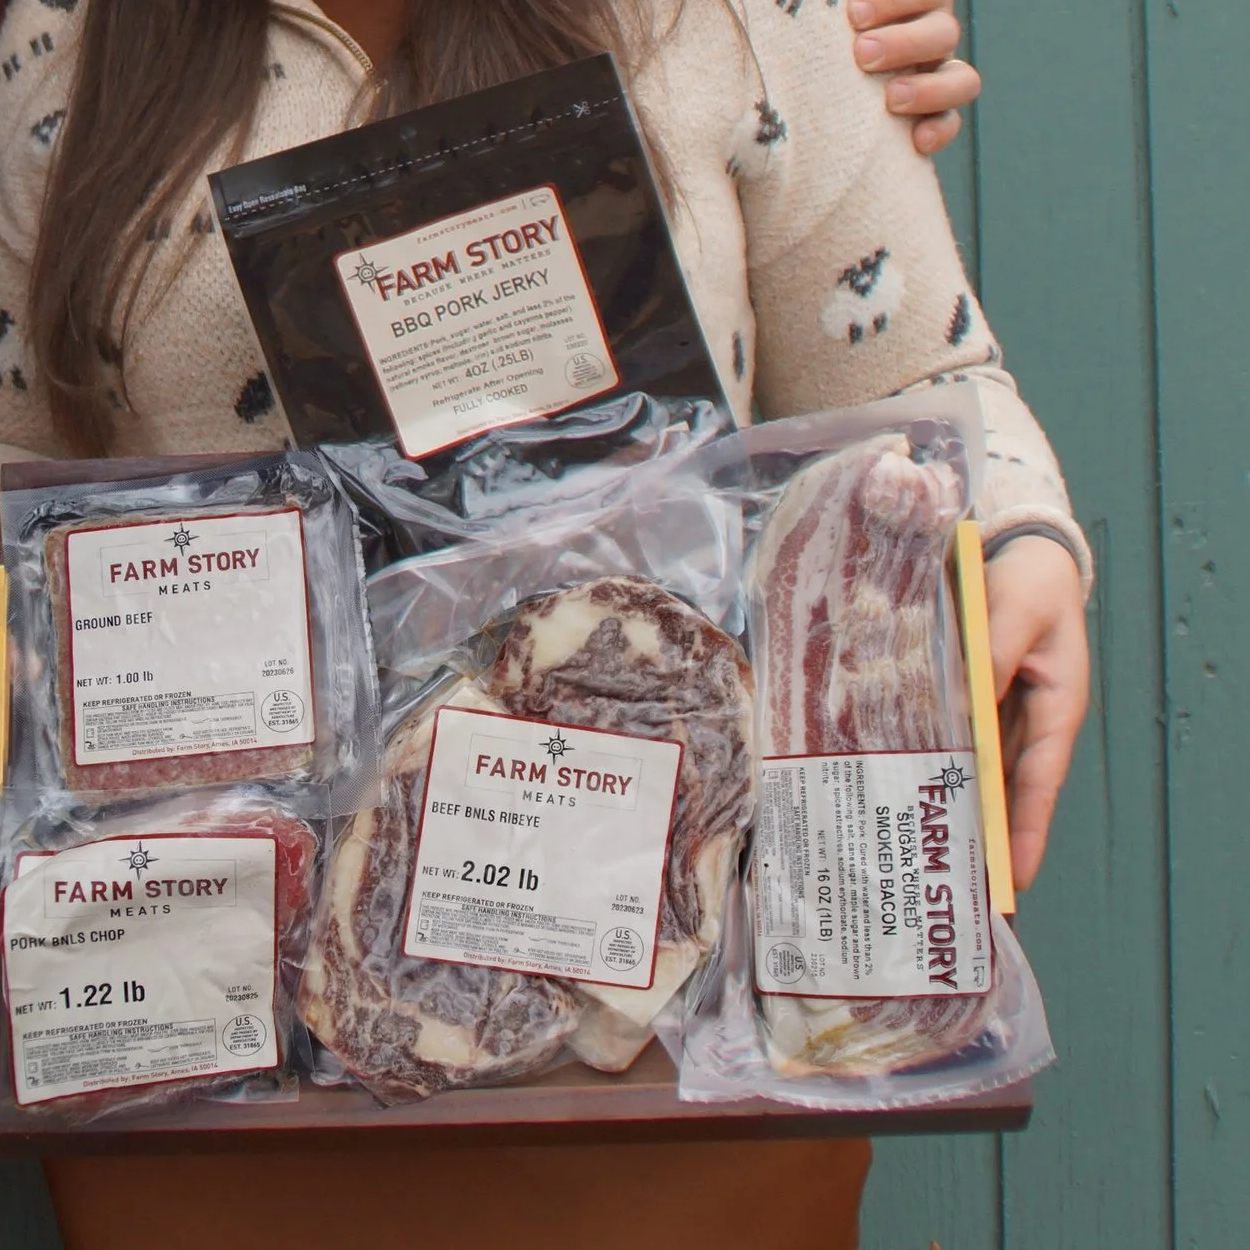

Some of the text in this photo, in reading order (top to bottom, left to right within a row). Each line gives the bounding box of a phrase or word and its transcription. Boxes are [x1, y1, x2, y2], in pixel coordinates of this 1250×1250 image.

[376, 215, 560, 301] FARM STORY
[404, 283, 454, 306] BECAUSE
[502, 249, 552, 270] MATTERS
[391, 268, 550, 338] BBQ PORK JERKY
[432, 367, 544, 408] Refrigerate After Opening
[453, 383, 528, 415] FULLY COOKED
[110, 548, 260, 583] FARM STORY
[159, 581, 211, 595] MEATS
[76, 612, 153, 630] GROUND BEEF
[265, 659, 276, 667] LOT
[77, 671, 154, 688] NET WT: 1.00 lb
[102, 695, 152, 705] REFRIGERATED
[165, 691, 191, 699] FROZEN
[138, 701, 169, 710] HANDLING
[171, 697, 215, 706] INSTRUCTIONS
[274, 692, 290, 702] U.S.
[475, 754, 632, 795] FARM STORY
[844, 760, 851, 769] of
[844, 770, 852, 782] the
[522, 790, 576, 807] MEATS
[833, 787, 841, 807] spice
[432, 801, 541, 827] BEEF BNLS RIBEYE
[800, 786, 809, 837] REFRIGERATED
[803, 838, 809, 847] OR
[817, 830, 825, 845] NET
[847, 842, 855, 860] cane
[859, 842, 868, 866] Cured
[423, 860, 538, 891] NET WT: 2.02 lb
[817, 868, 831, 881] 16
[837, 857, 846, 885] sodium
[861, 869, 869, 883] with
[876, 806, 897, 935] SMOKED BACON
[896, 812, 918, 927] SUGAR CURED
[54, 878, 228, 902] FARM STORY
[818, 885, 832, 903] OZ
[862, 886, 870, 907] water
[918, 784, 957, 990] FARM STORY
[968, 837, 982, 951] farmstorymeats.com
[422, 891, 441, 900] KEEP
[442, 893, 493, 907] REFRIGERATED
[507, 902, 534, 912] FROZEN
[616, 894, 627, 902] LOT
[850, 889, 859, 912] maple
[110, 905, 171, 917] MEATS
[461, 904, 478, 913] SAFE
[478, 906, 509, 917] HANDLING
[863, 909, 871, 923] and
[816, 907, 833, 941] (1LB)
[850, 914, 859, 936] sugar
[11, 929, 125, 950] PORK BNLS CHOP
[615, 930, 632, 940] U.S.
[914, 915, 923, 970] MATTERS
[840, 935, 849, 964] sodium
[852, 938, 860, 953] and
[864, 944, 872, 961] than
[853, 955, 861, 979] brown
[865, 963, 873, 975] 2%
[15, 981, 145, 1015] NET WT: 1.22 lb
[23, 1031, 43, 1039] KEEP
[46, 1023, 104, 1036] REFRIGERATED
[118, 1019, 147, 1027] FROZEN
[70, 1023, 174, 1041] SAFE HANDLING INSTRUCTIONS
[235, 1017, 252, 1027] U.S.
